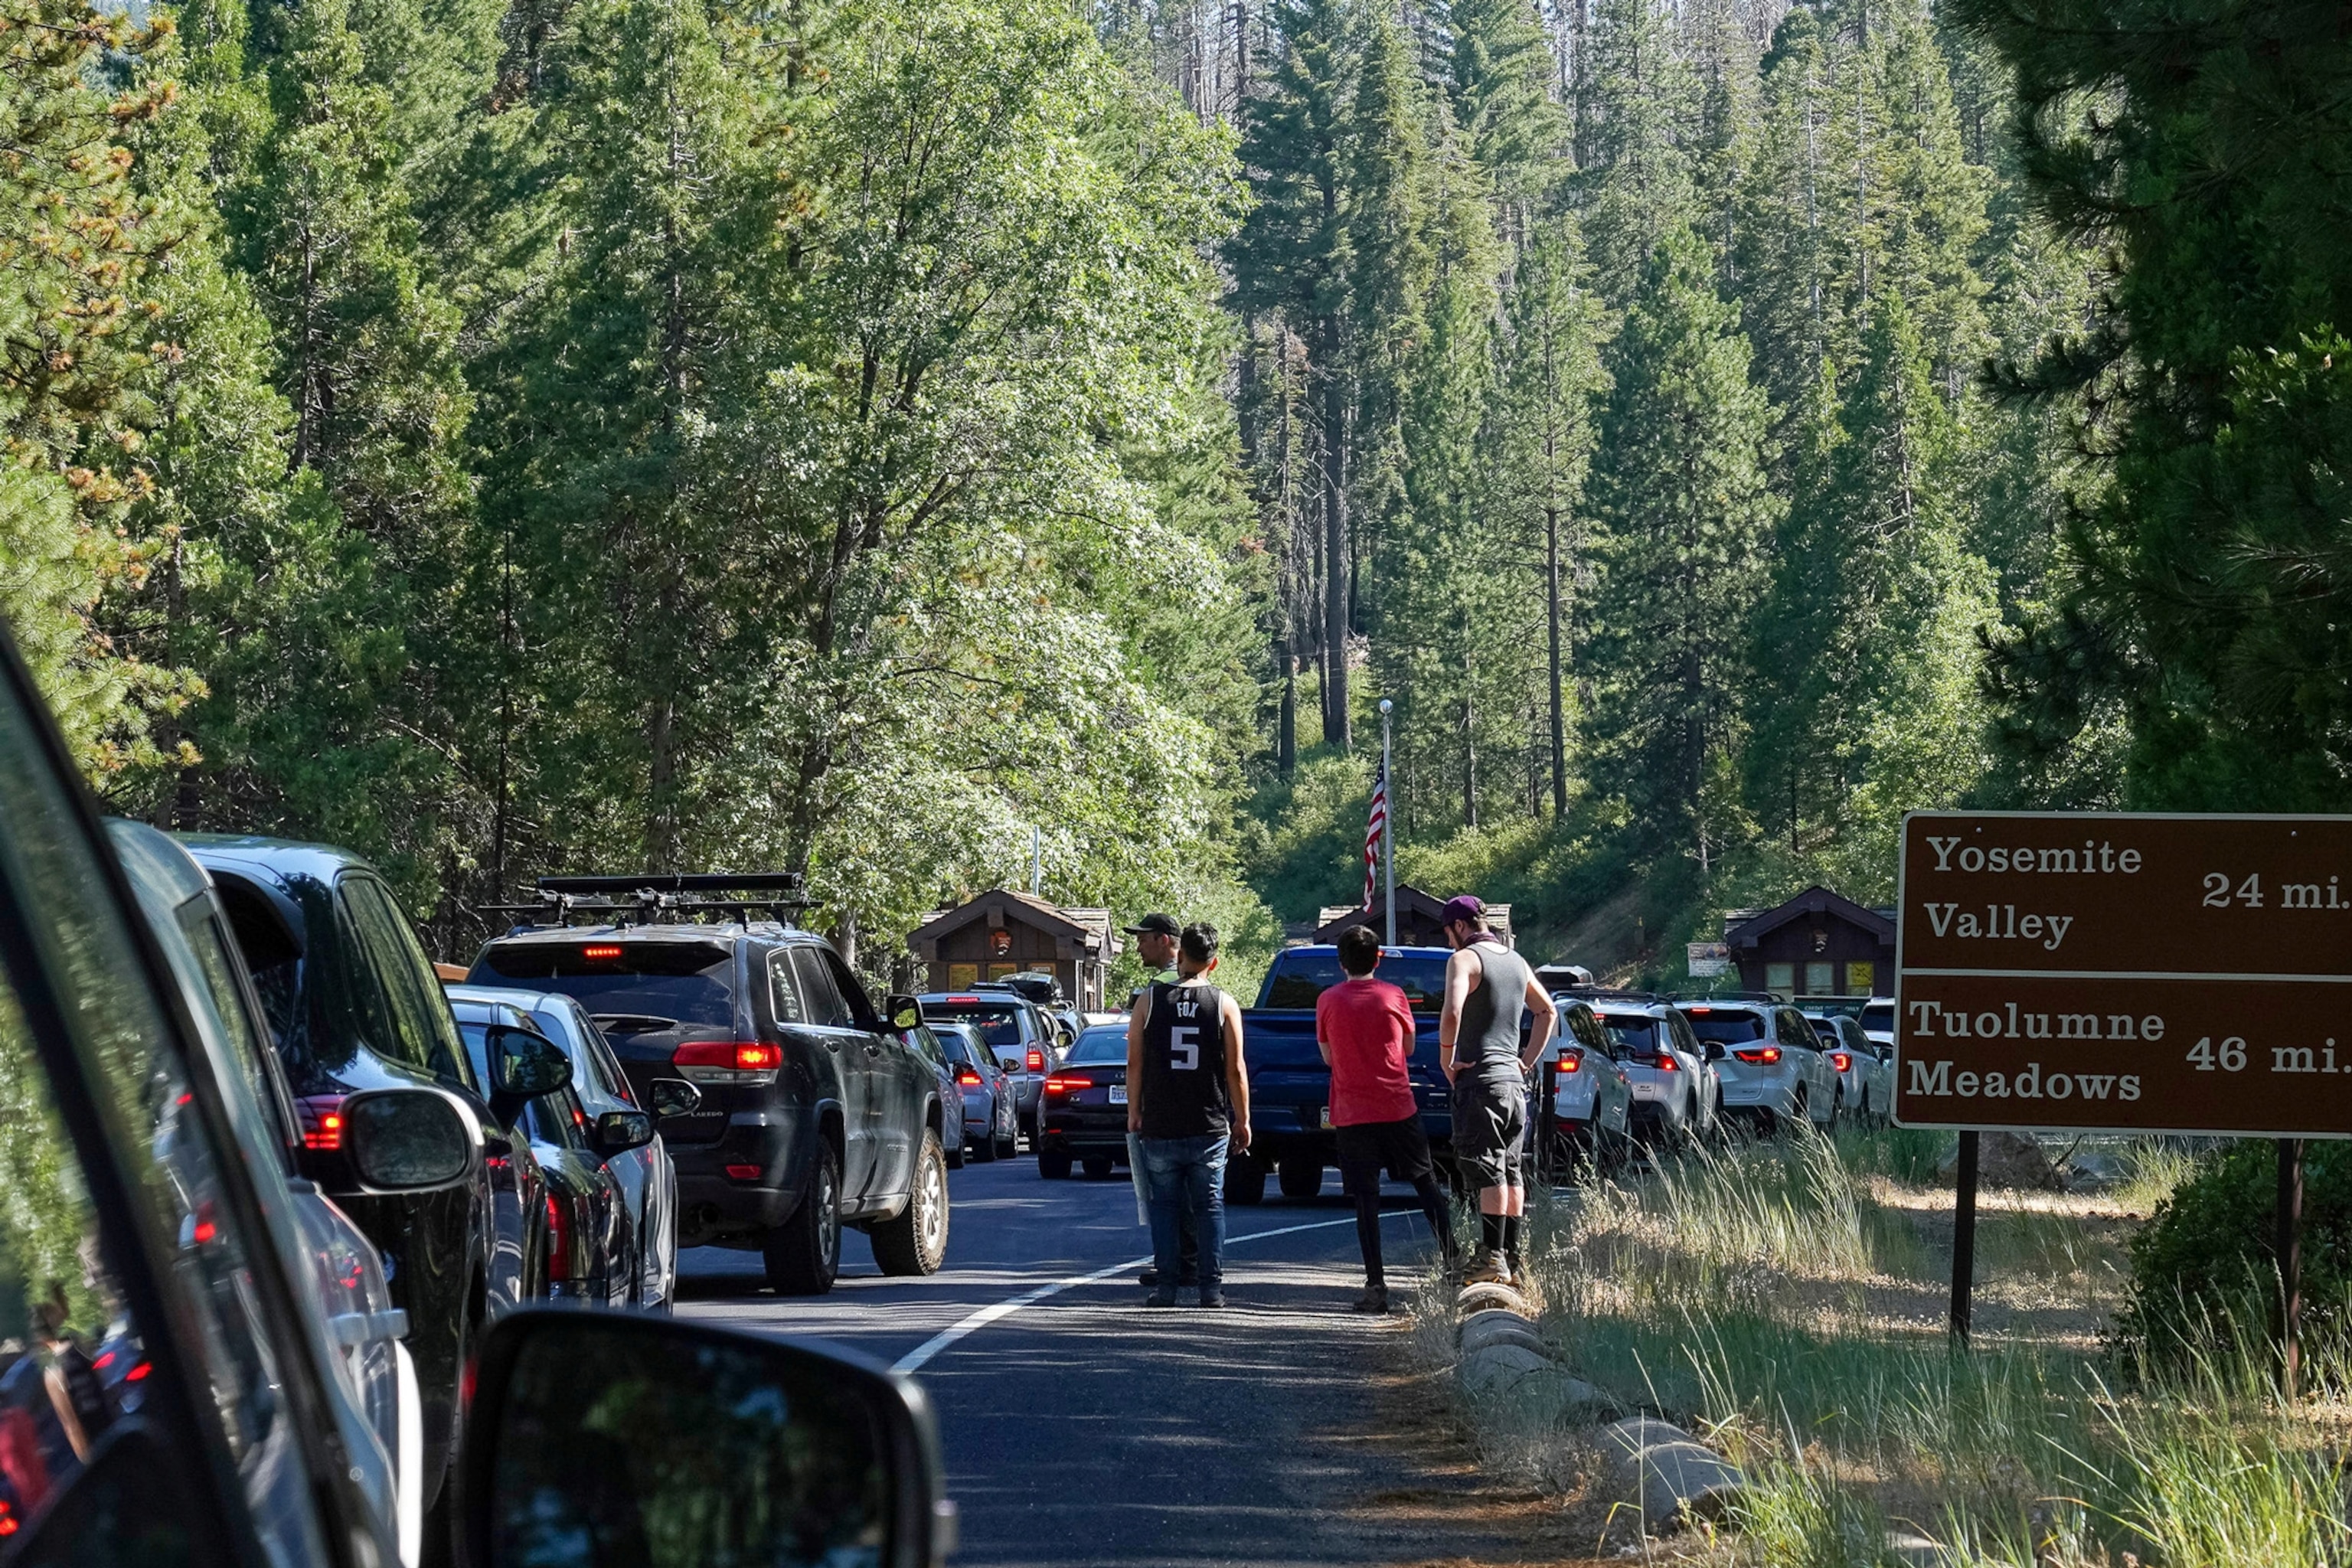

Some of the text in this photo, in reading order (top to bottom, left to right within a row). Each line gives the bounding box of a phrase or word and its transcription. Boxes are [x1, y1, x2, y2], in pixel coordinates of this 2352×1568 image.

[1926, 837, 2141, 874] Yosemite
[2203, 872, 2350, 909] 24 mi.
[1923, 903, 2073, 951] Valley
[1176, 1001, 1199, 1018] FOX
[1909, 1001, 2165, 1041] Tuolumne
[1171, 1026, 1200, 1070] 5
[2186, 1037, 2352, 1073] 46 mi.
[1906, 1060, 2141, 1101] Meadows
